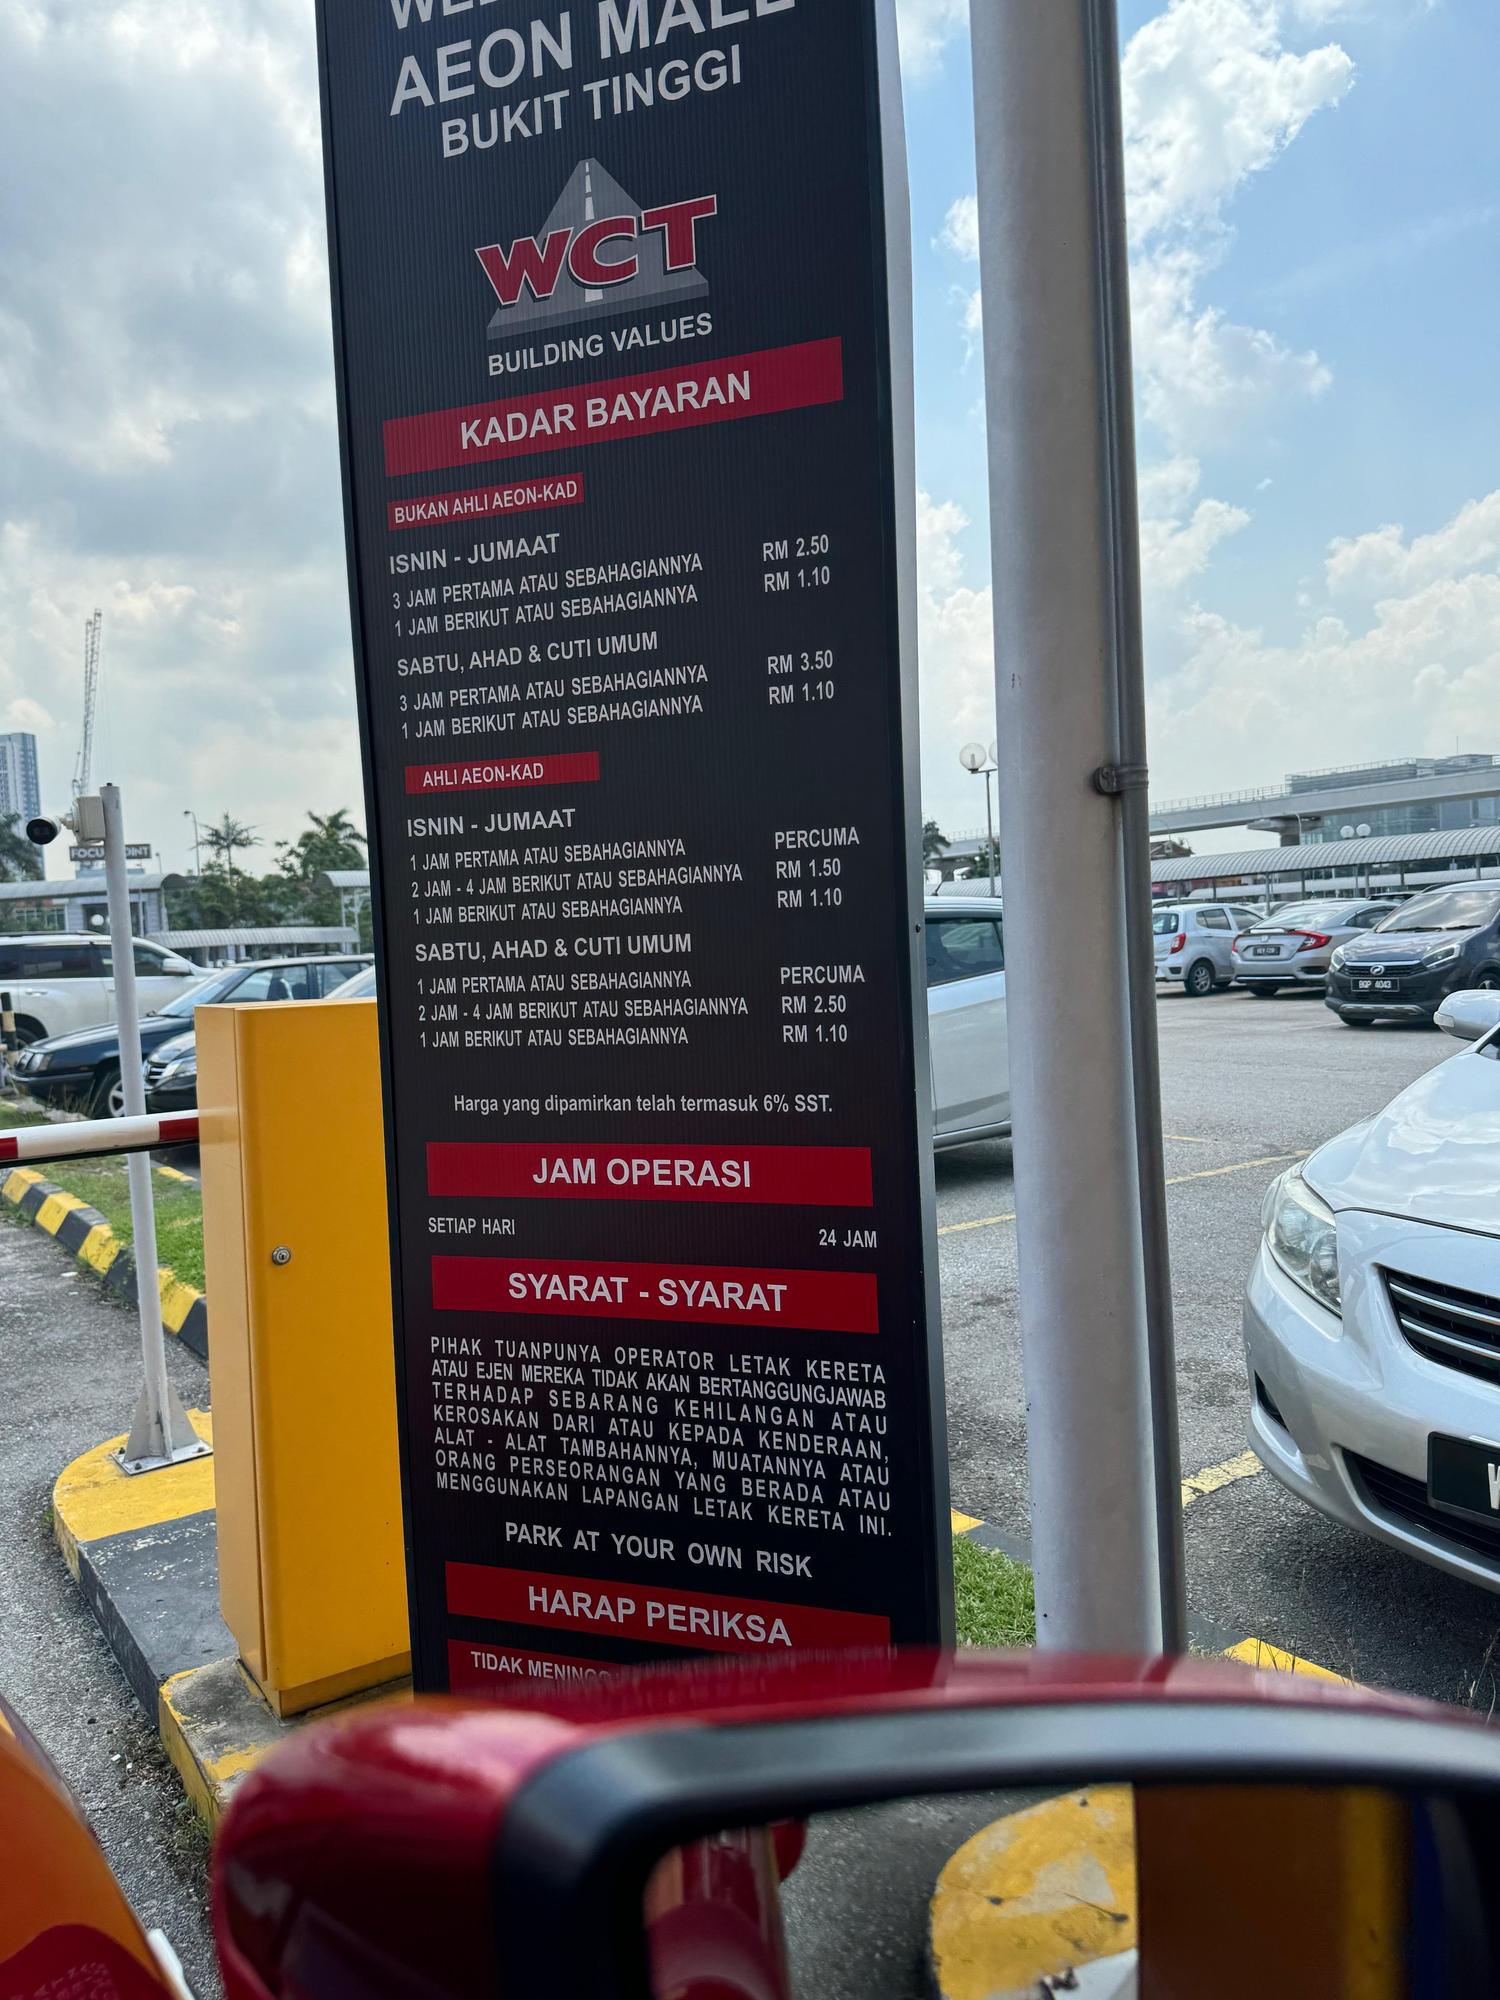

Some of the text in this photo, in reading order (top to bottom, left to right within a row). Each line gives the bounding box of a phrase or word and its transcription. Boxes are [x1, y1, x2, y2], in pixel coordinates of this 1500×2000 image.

[389, 10, 573, 117] AEON
[441, 43, 741, 159] BUKIT TINGGI
[475, 194, 717, 305] WCT
[488, 312, 713, 377] BUILDING VALUES
[461, 370, 751, 450] KADAR BAYARAN
[394, 480, 577, 524] BUKAN AHLI AEON-KAD
[389, 532, 560, 575] ISNIN JUMAAT
[762, 534, 829, 562] RM 2.50
[406, 552, 703, 608] JAM PERTAMA ATAU SEBAHAGIANNYA
[764, 565, 830, 593] RM 1.10
[408, 584, 698, 636] JAM BERIKUT ATAU SEBAHAGIANNYA
[397, 631, 658, 677] SABTU, AHAD CUTI UMUM
[767, 649, 833, 675] RM 3.50
[413, 664, 709, 711] JAM PERTAMA ATAU SEBAHAGIANNYA
[768, 680, 834, 705] RM 1.10
[415, 694, 704, 738] JAM BERIKUT ATAU SEBAHAGIANNYA
[422, 762, 544, 787] AHLI AEON-KAD
[407, 808, 576, 838] ISNIN JUMAAT
[774, 826, 860, 850] PERCUMA
[71, 847, 148, 859] FOCU OINT
[422, 838, 686, 871] JAM PERTAMA ATAU SEBAHAGIANNYA
[776, 857, 841, 879] RM 1.50
[423, 863, 743, 898] JAM JAM BERIKUT ATAU SEBAHAGIANNYA
[425, 895, 683, 925] JAM BERIKUT ATAU SEBAHAGIANNYA
[777, 887, 842, 909] RM 1.10
[415, 933, 692, 963] SABTU, AHAD CUTI UMUM
[429, 969, 692, 995] JAM PERTAMA ATAU SEBAHAGIANNYA
[780, 964, 866, 985] PERCUMA
[430, 997, 749, 1021] JAM JAM BERIKUT ATAU SEBAHAGIANNYA
[781, 994, 847, 1014] RM 2.50
[432, 1026, 689, 1048] JAM BERIKUT ATAU SEBAHAGIANNYA
[782, 1024, 848, 1043] RM 1.10
[454, 1094, 833, 1116] Harga yang dipamirkan telah termasuk 6% SST.
[532, 1157, 751, 1188] JAM OPERASI
[428, 1217, 516, 1235] SETIAP HARI
[818, 1228, 877, 1249] 24 JAM
[508, 1272, 788, 1312] SYARAT SYARAT
[430, 1336, 886, 1384] PIHAK TUANPUNYA OPERATOR LETAK KERETA
[431, 1358, 887, 1409] ATAU EJEN MEREKA TIDAK AKAN BERTANGGUNGJAWAB
[431, 1381, 887, 1435] TERHADAP SEBARANG KEHILANGAN ATAU
[433, 1403, 889, 1464] KEROSAKAN DARI ATAU KEPADA KENDERAAN,
[434, 1426, 889, 1486] ALAT ALAT TAMBAHANNYA, MUATANNYA ATAU
[435, 1449, 890, 1511] ORANG PERSEORANGAN YANG BERADA ATAU
[436, 1471, 892, 1537] MENGGUNAKAN LAPANGAN LETAK KERETA INI.
[505, 1521, 813, 1578] PARK AT YOUR OWN RISK
[528, 1585, 793, 1647] HARAP PERIKSA
[470, 1650, 524, 1675] TIDAK
